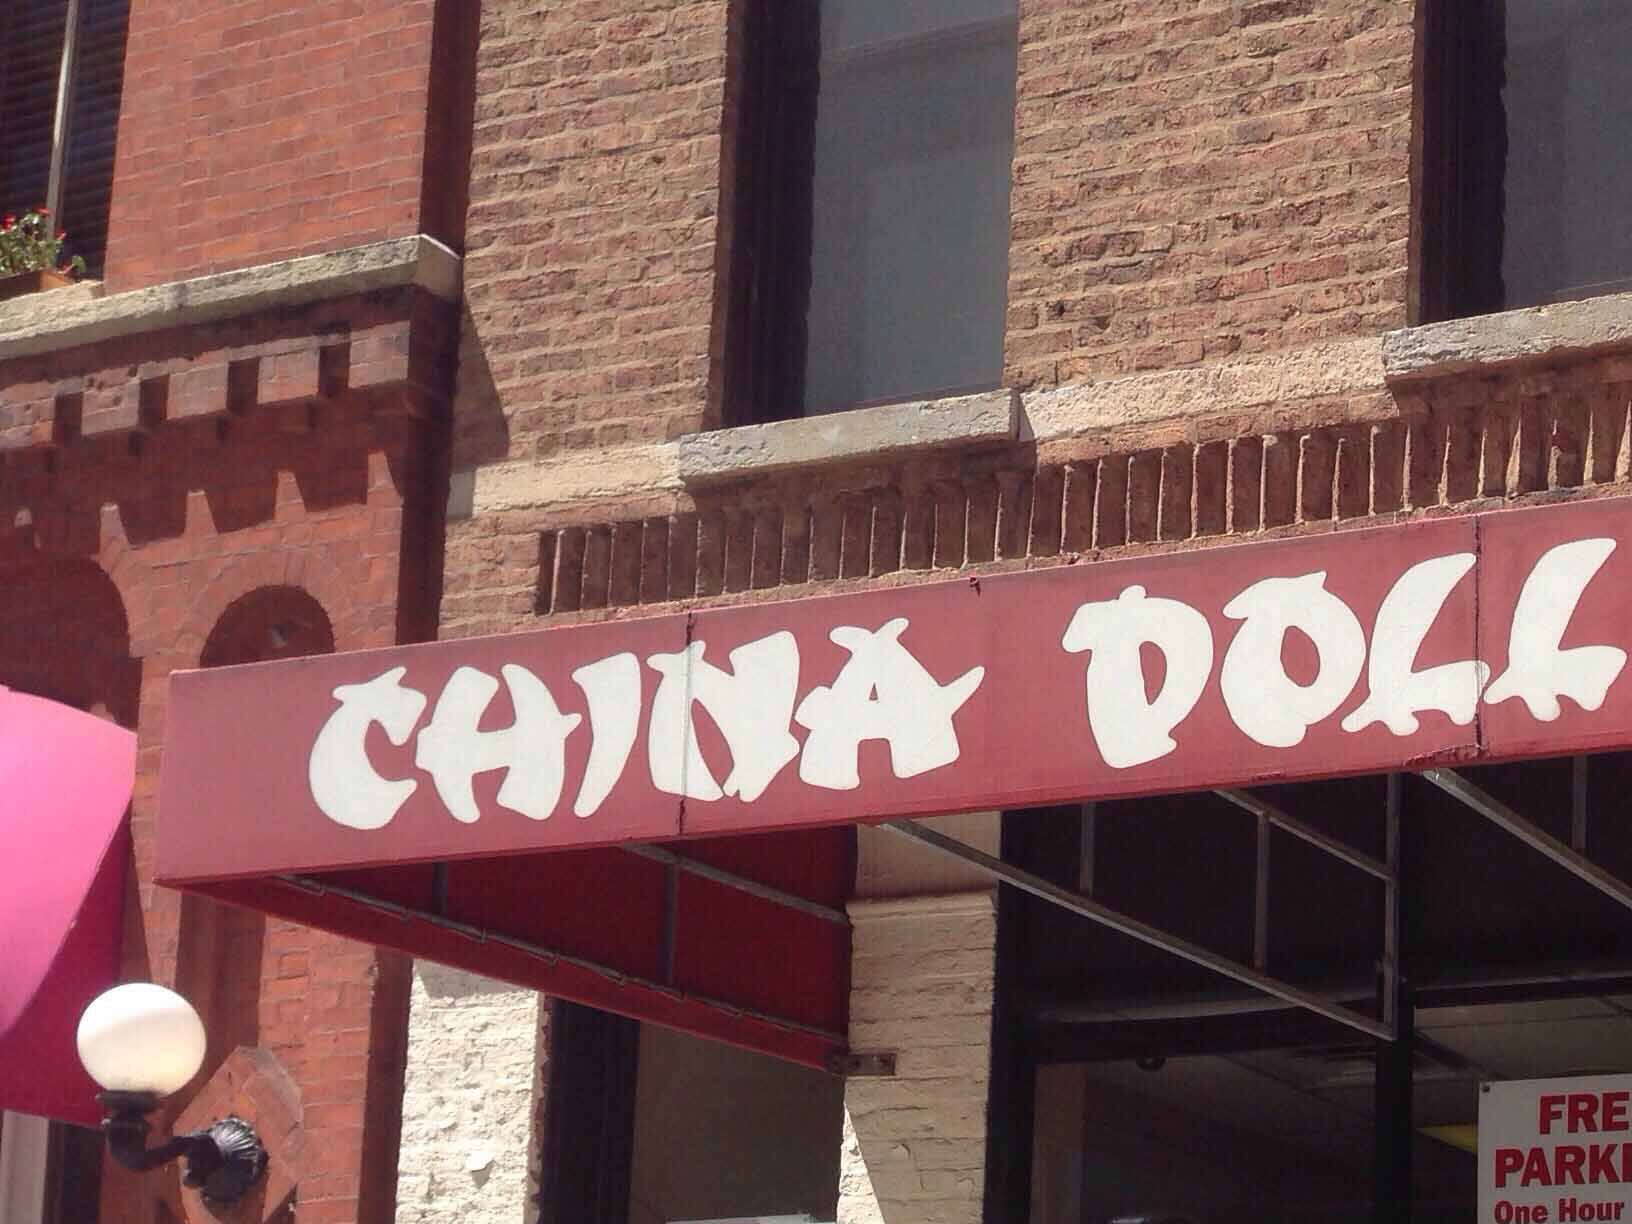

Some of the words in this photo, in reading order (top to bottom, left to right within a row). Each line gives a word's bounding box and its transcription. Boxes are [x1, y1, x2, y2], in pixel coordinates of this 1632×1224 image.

[309, 617, 985, 830] CHINA
[1061, 537, 1628, 769] DOLL
[1494, 1201, 1548, 1224] One
[1559, 1198, 1624, 1223] Hour
